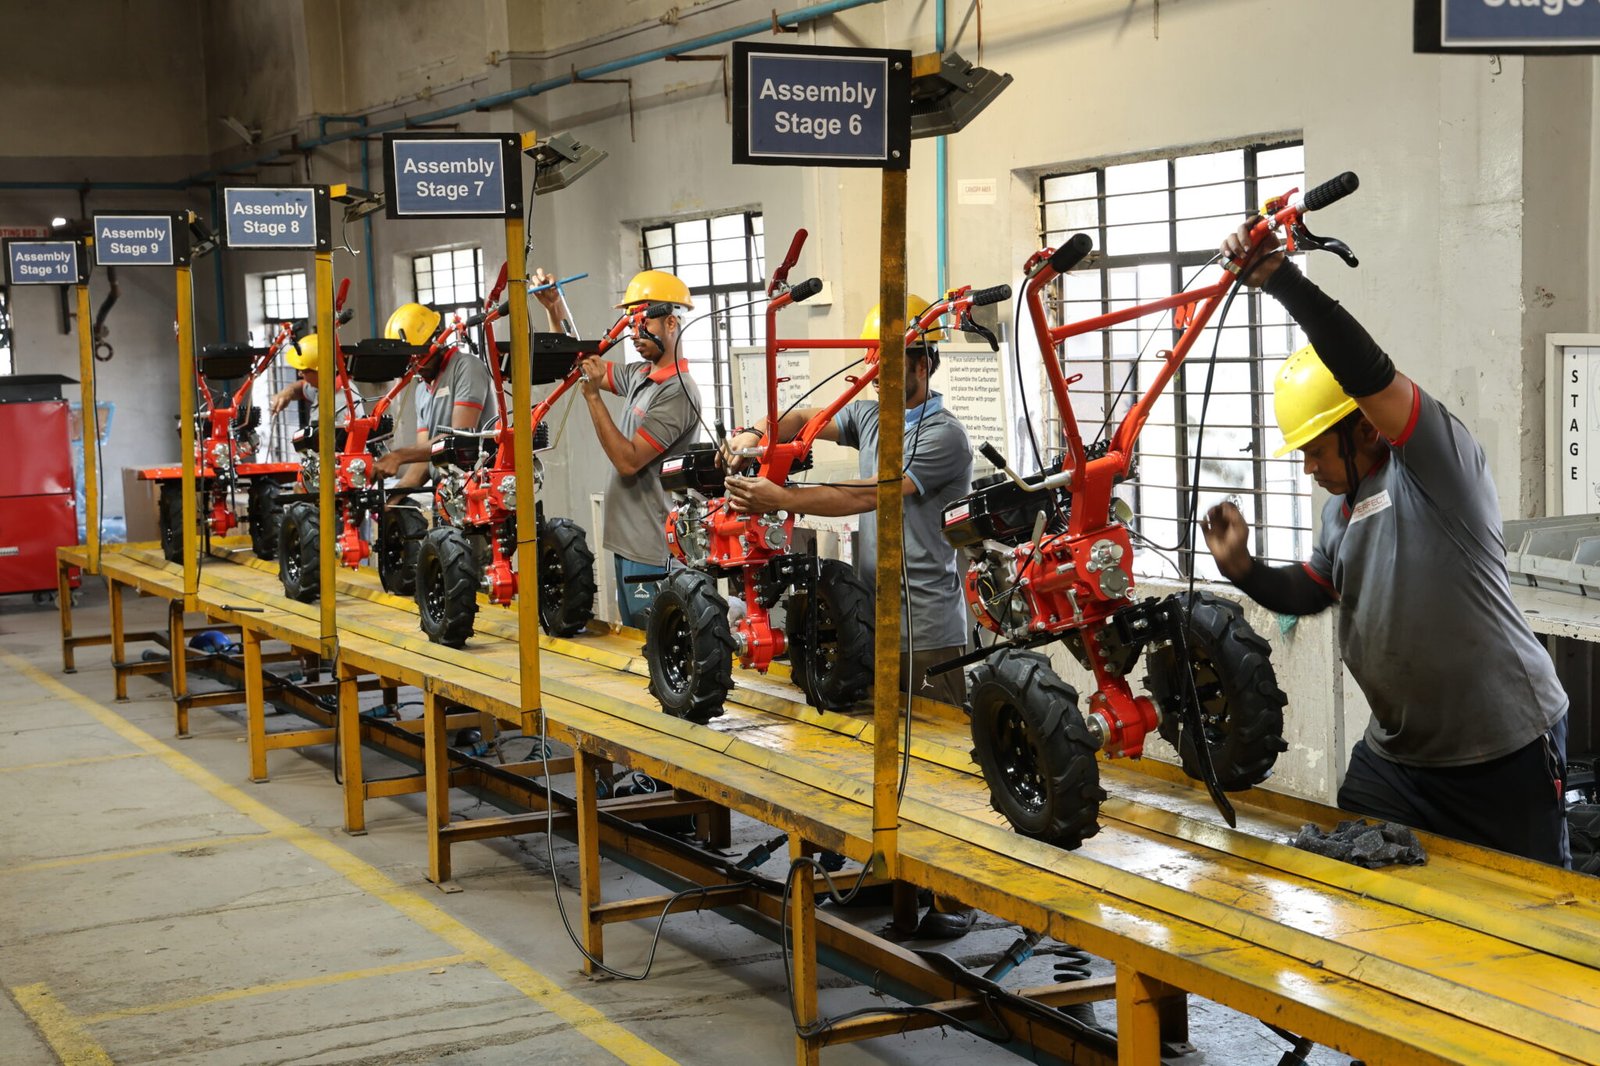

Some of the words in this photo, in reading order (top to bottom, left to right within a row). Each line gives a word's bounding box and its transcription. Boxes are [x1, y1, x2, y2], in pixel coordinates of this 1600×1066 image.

[759, 78, 877, 109] Assembly
[774, 111, 842, 140] Stage
[849, 114, 863, 136] 6
[403, 157, 495, 177] Assembly
[416, 181, 469, 201] Stage
[474, 181, 485, 196] 7
[233, 201, 308, 218] Assembly
[101, 227, 166, 241] Assembly
[243, 220, 287, 236] Stage
[290, 220, 300, 233] 8
[15, 251, 71, 263] Assembly
[110, 242, 148, 256] Stage
[150, 242, 159, 254] 9
[20, 264, 53, 277] Stage
[55, 264, 68, 274] 10
[1569, 369, 1579, 480] STAGE
